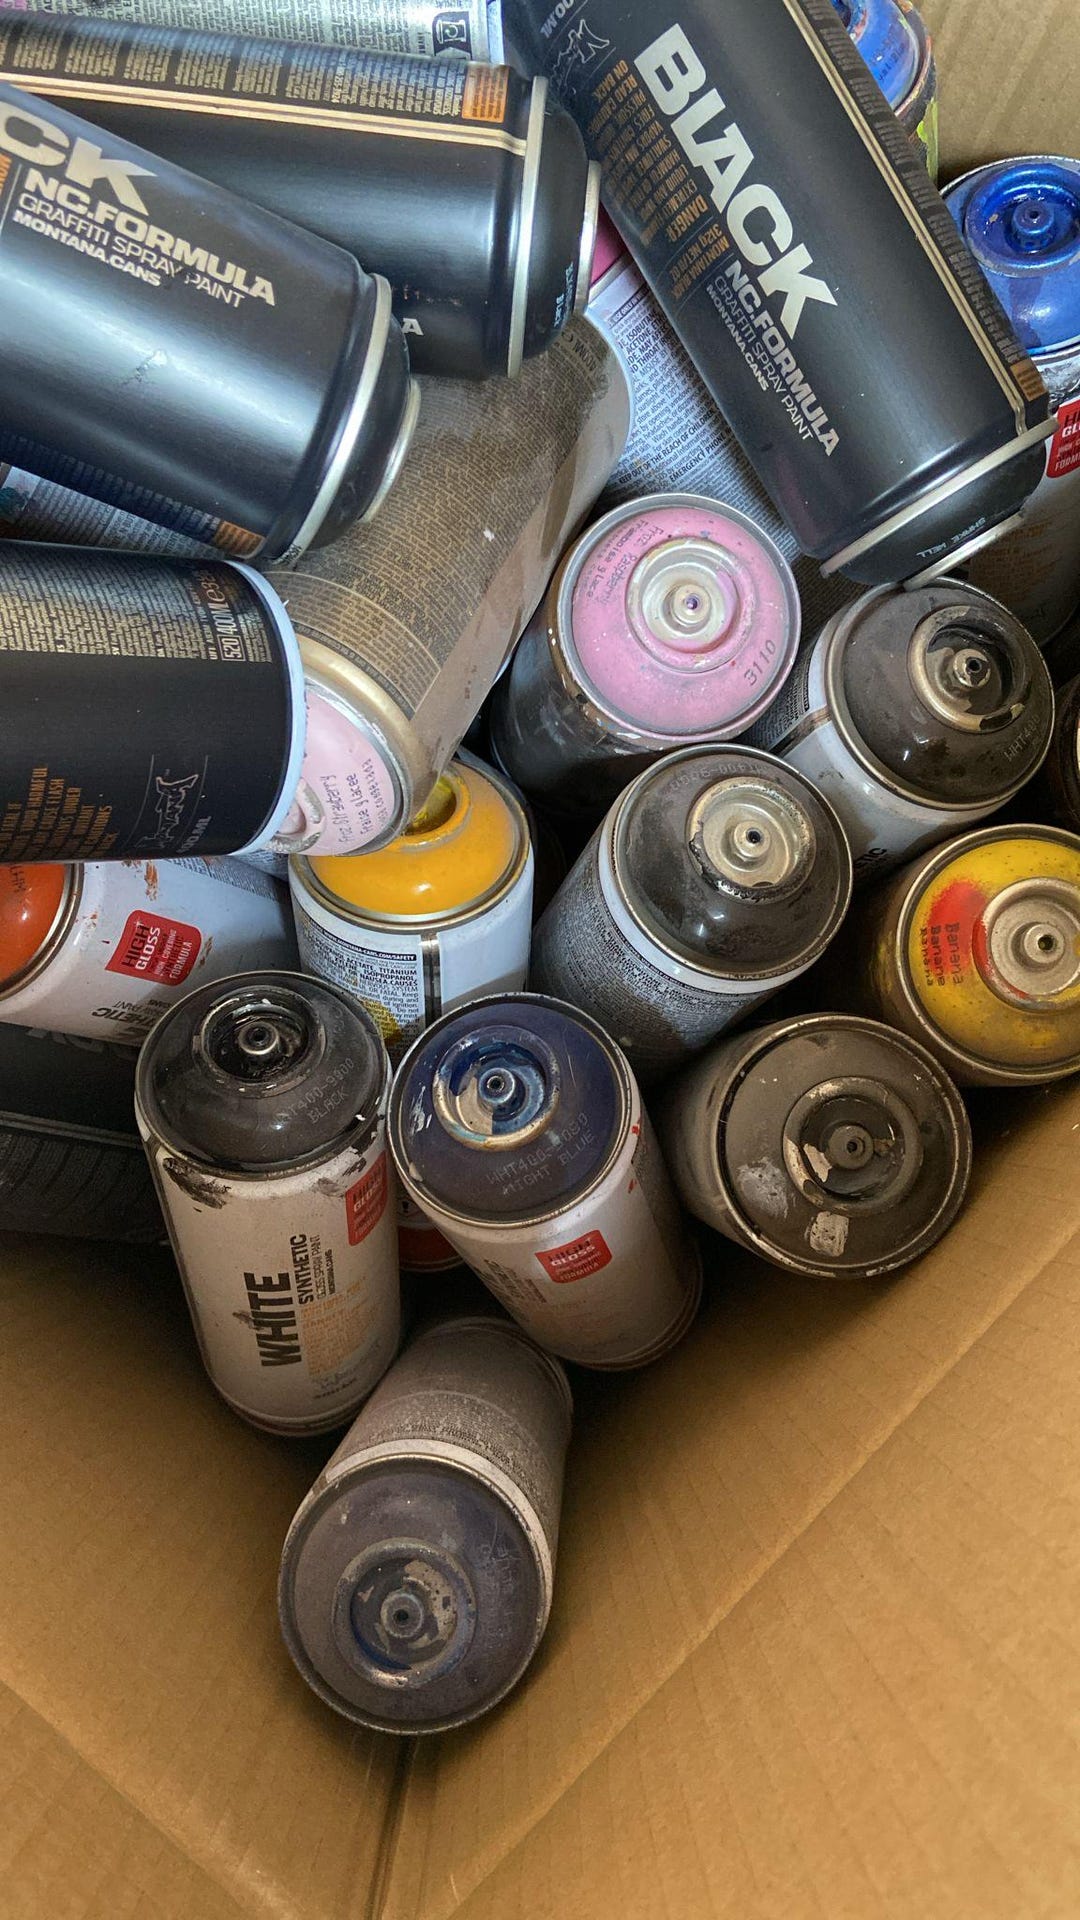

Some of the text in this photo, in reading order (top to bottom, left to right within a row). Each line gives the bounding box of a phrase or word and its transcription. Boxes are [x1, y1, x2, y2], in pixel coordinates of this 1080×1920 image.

[613, 74, 638, 100] READ
[634, 23, 838, 340] BLACK
[13, 209, 162, 287] MONTANA.CANS
[19, 192, 111, 245] GRAFFITI
[112, 235, 183, 279] SPRAY
[24, 168, 275, 306] NC.FORMULA
[697, 222, 723, 248] 312g
[689, 236, 728, 279] MONTANA
[636, 343, 662, 366] THROAT
[637, 338, 654, 354] MAY
[706, 284, 769, 391] MONTANA.CANS
[714, 275, 814, 440] GRAFFITI SPRAY PAINT
[726, 260, 840, 456] NC.FORMULA
[638, 356, 660, 376] MISUSE
[650, 427, 669, 443] Wash
[618, 471, 633, 485] KEEP
[630, 464, 645, 478] OUT
[649, 451, 664, 465] THE
[660, 437, 682, 456] REACH
[678, 430, 690, 442] OF
[666, 432, 728, 482] EMERGENCY PHONE
[916, 516, 986, 559] SHAKE WELL
[222, 638, 240, 656] 520
[744, 639, 778, 687] 3110
[46, 777, 64, 804] FLASH
[122, 924, 149, 967] HIGH
[135, 926, 161, 970] GLOSS
[169, 940, 192, 980] FORMULA
[930, 924, 946, 988] Banane
[944, 921, 965, 986] Banana
[379, 968, 417, 977] TITANIUM
[308, 1092, 350, 1125] BLACK
[558, 1130, 597, 1167] BLUE
[290, 1233, 315, 1305] SYNTHETIC
[243, 1271, 303, 1367] WHITE
